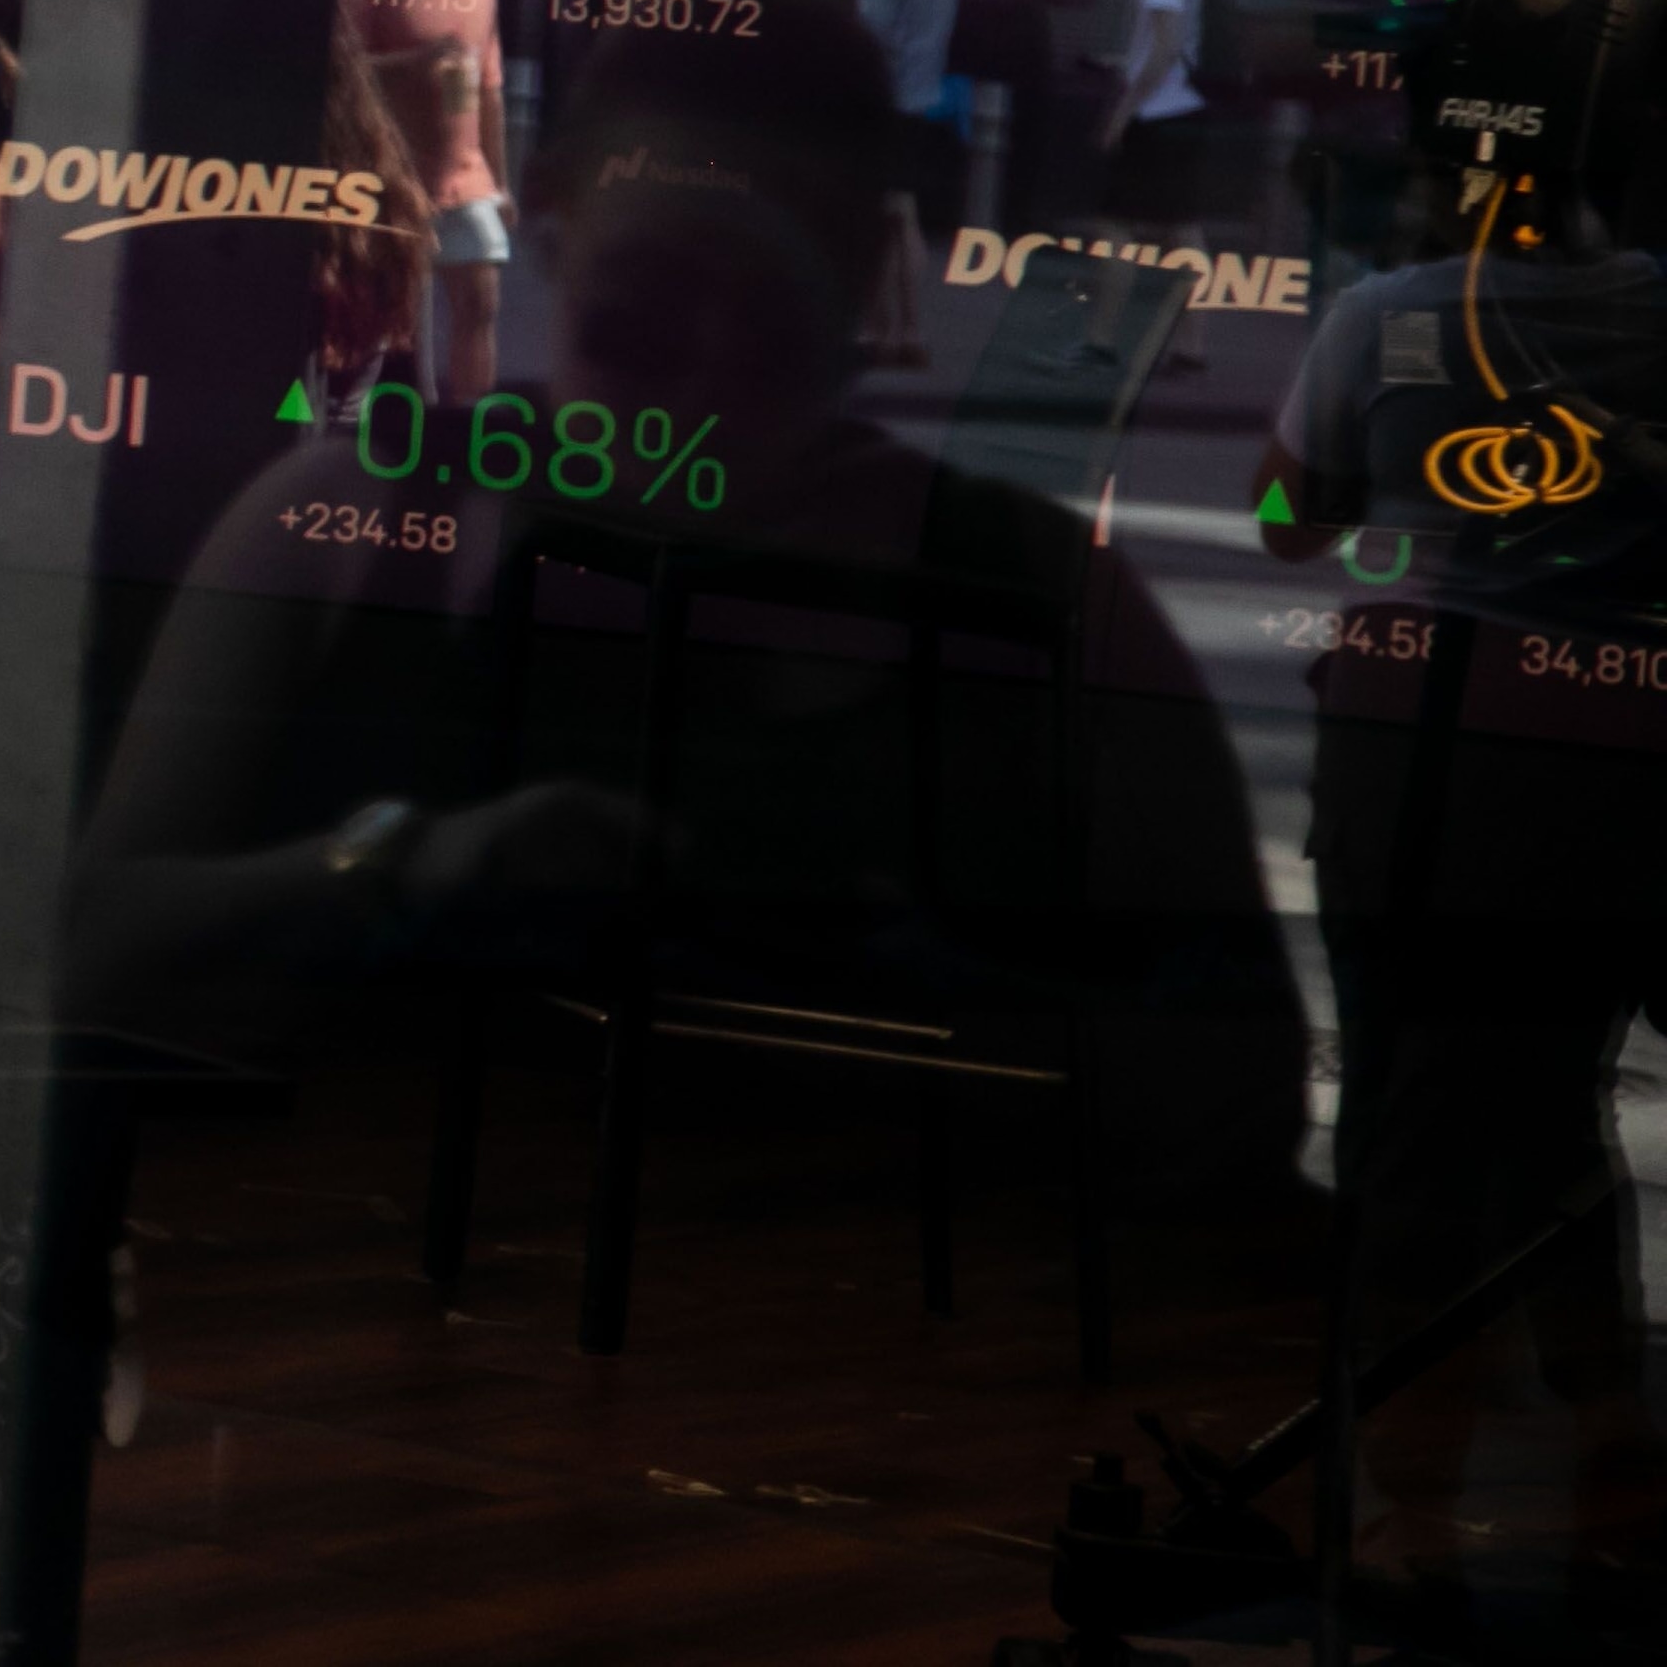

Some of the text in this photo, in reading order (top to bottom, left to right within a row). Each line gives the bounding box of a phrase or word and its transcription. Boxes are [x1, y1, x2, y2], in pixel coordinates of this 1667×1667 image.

[8, 362, 149, 448] DJI
[357, 380, 727, 513] 0.68%
[277, 500, 458, 557] +234.58
